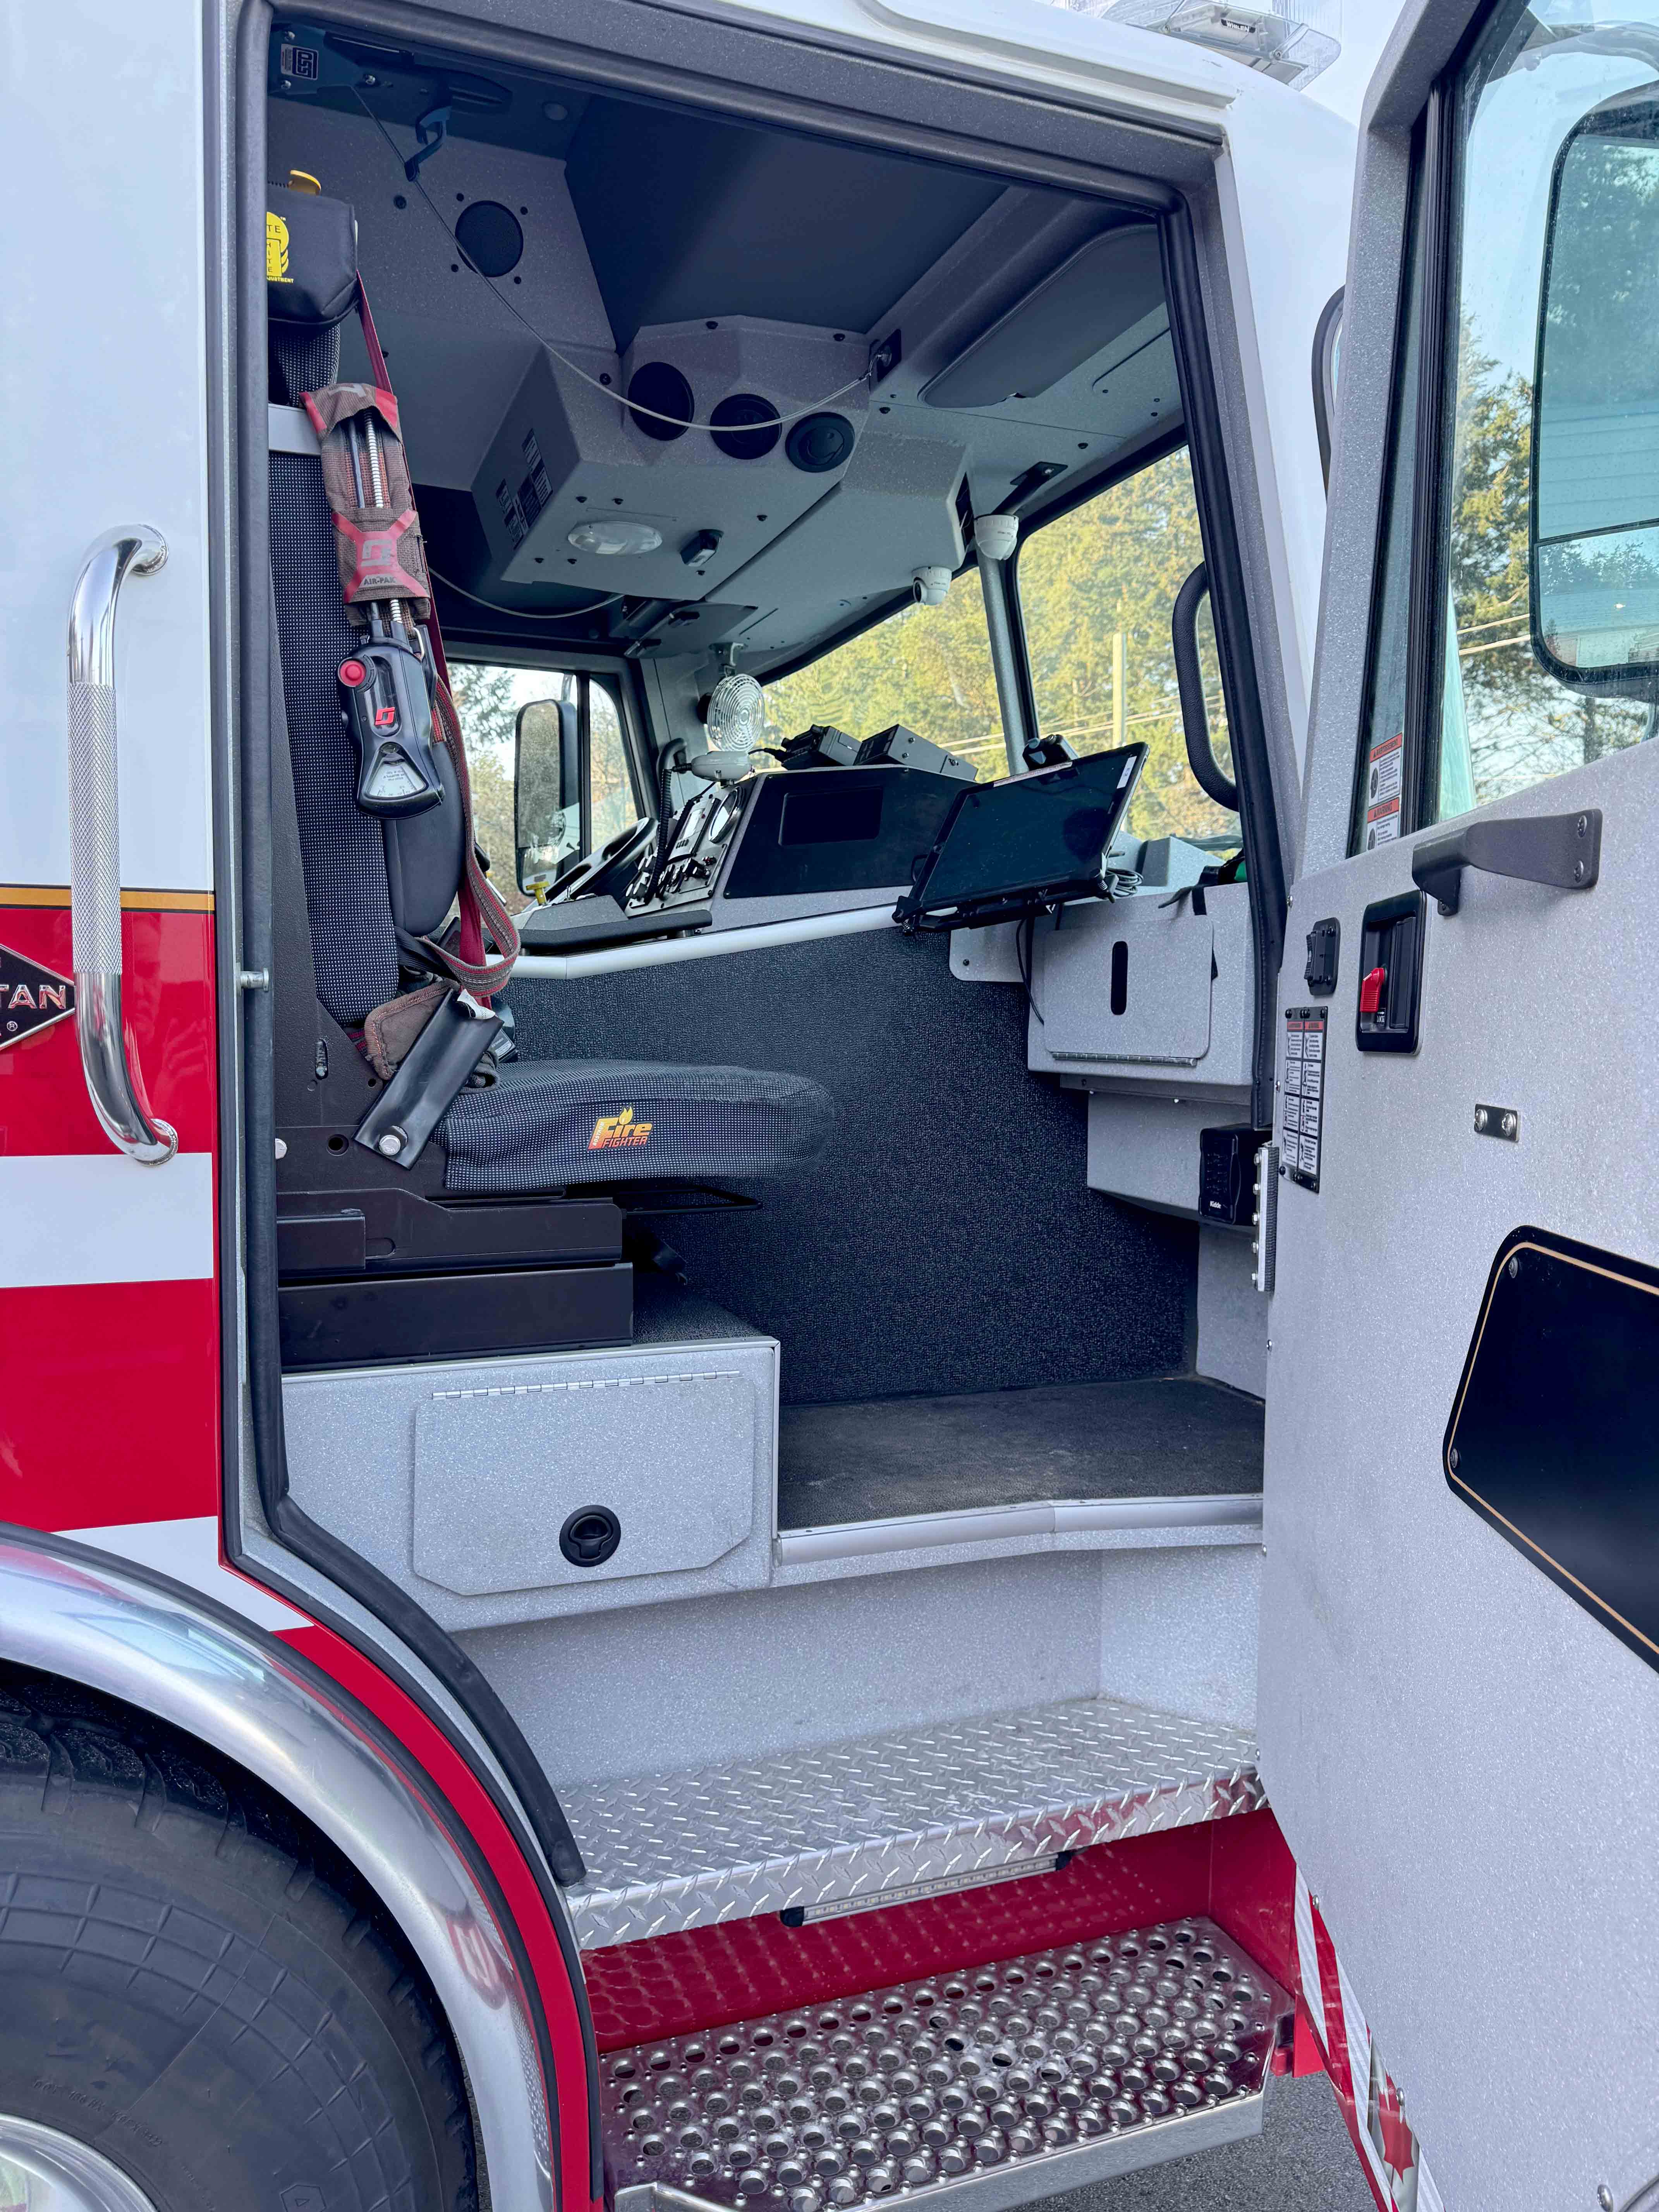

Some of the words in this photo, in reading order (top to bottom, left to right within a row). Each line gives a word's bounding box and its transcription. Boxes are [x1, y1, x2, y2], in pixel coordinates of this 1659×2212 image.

[1226, 21, 1249, 32] WHELEN
[588, 1106, 653, 1150] Fire
[602, 1136, 648, 1148] FIGHTER
